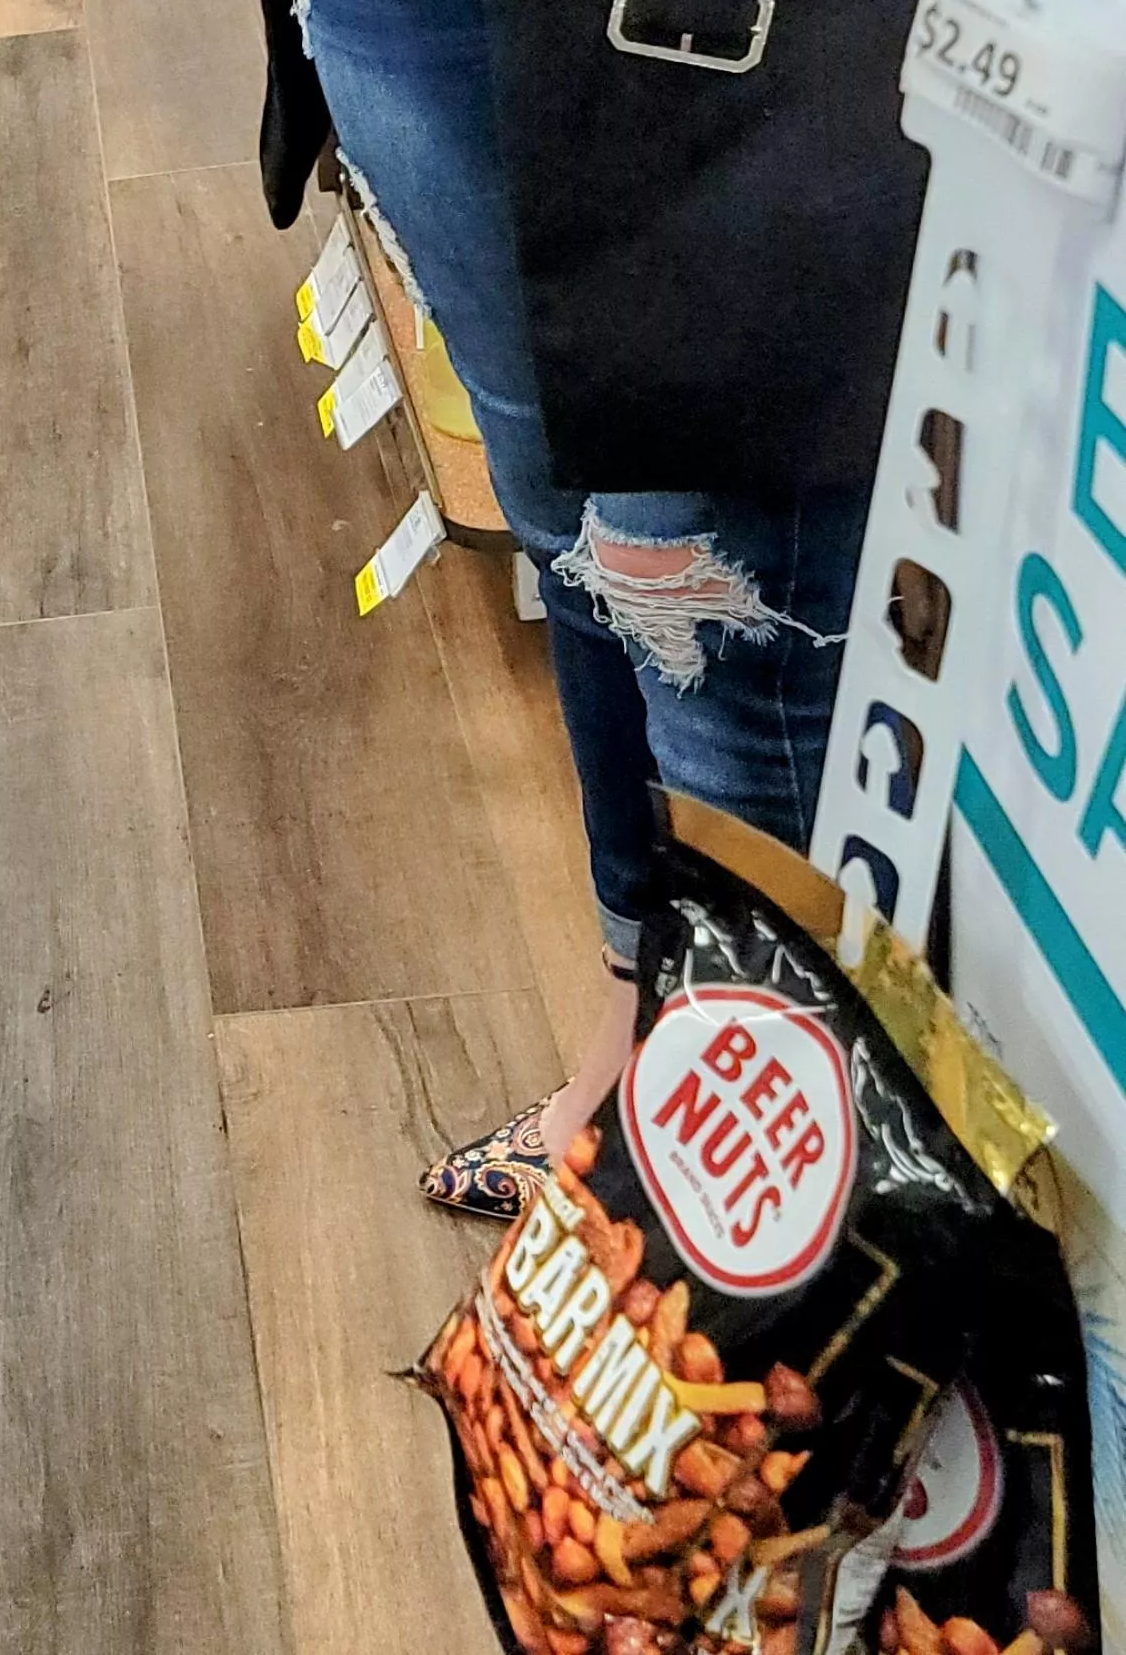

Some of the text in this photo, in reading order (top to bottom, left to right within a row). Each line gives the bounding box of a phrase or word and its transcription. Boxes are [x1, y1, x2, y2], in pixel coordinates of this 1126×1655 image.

[916, 0, 1022, 98] $2.49
[650, 1067, 782, 1248] NUTS
[699, 1019, 826, 1192] BEER
[505, 1195, 612, 1378] BAR
[572, 1312, 703, 1498] MIX
